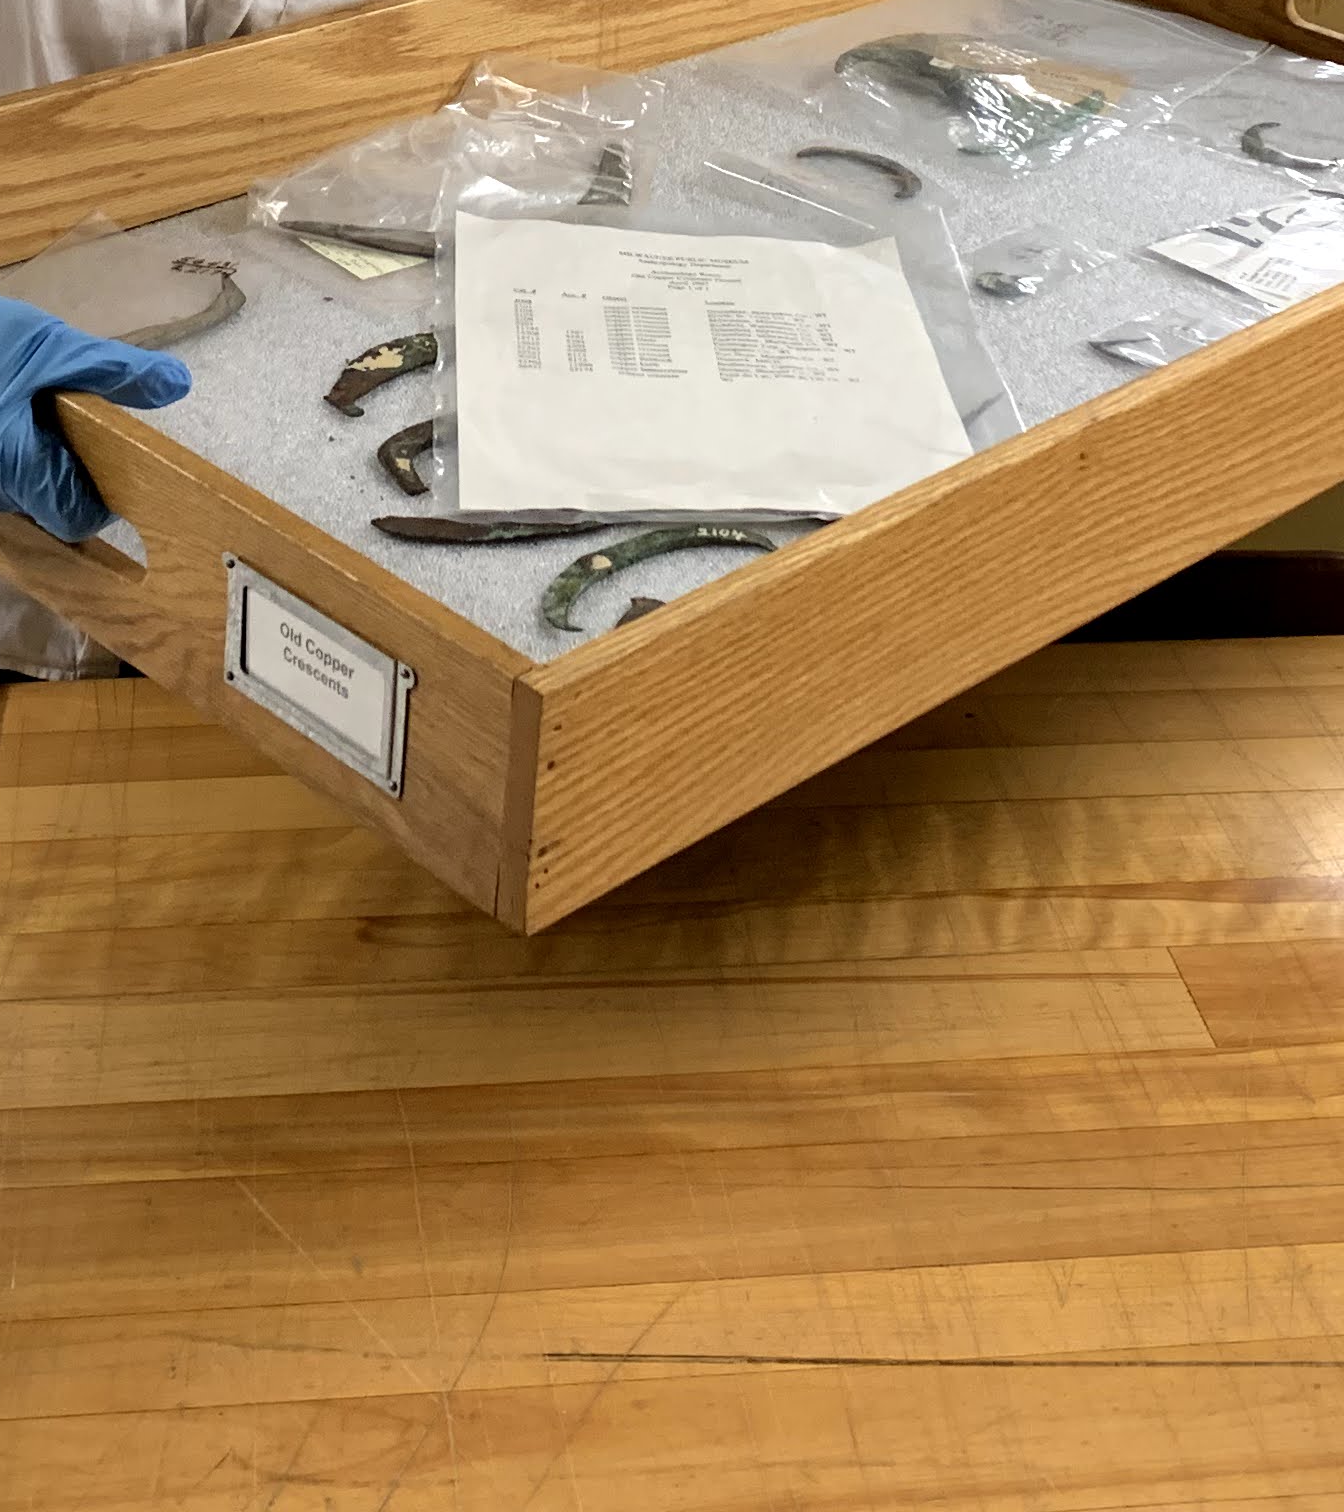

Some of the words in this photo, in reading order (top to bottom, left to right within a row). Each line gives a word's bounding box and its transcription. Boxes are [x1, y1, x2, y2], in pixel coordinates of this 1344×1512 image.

[280, 622, 302, 647] Old
[305, 638, 354, 679] Copper
[284, 646, 349, 698] Crescents
